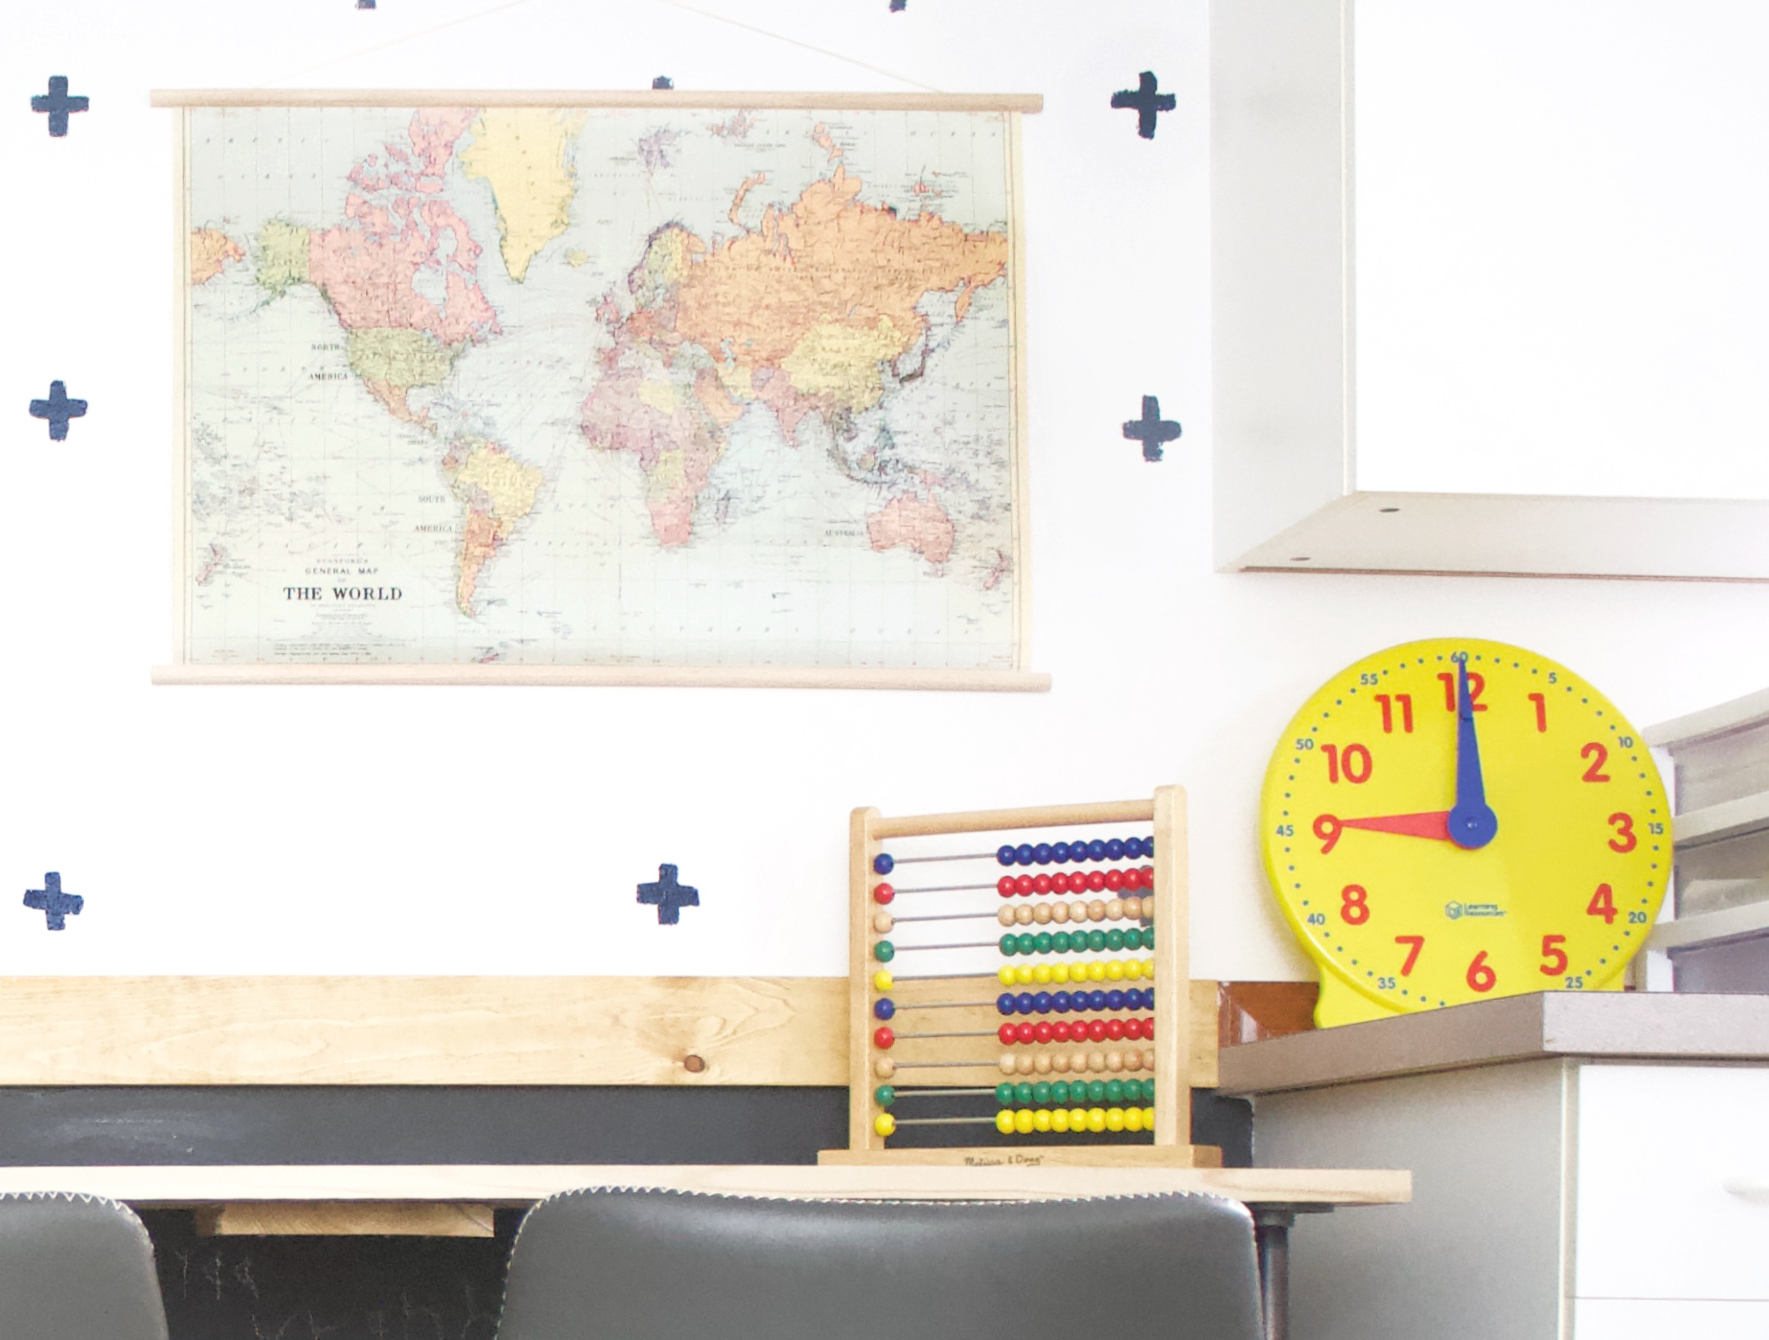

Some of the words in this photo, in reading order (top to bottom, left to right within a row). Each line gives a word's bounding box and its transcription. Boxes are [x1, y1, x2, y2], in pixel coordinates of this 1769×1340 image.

[415, 525, 453, 533] AMERICA
[305, 567, 352, 576] GENERAL
[358, 566, 379, 575] MAP
[283, 587, 323, 601] THE
[332, 587, 403, 601] WORLD
[1360, 672, 1379, 686] 55
[1548, 672, 1558, 685] 5
[1437, 671, 1488, 712] 12
[1374, 694, 1414, 734] 11
[1528, 692, 1547, 733] 1
[1295, 738, 1314, 751] 50
[1617, 735, 1634, 749] 10
[1321, 743, 1373, 784] 10
[1581, 742, 1611, 783] 2
[1275, 823, 1295, 837] 45
[1312, 813, 1343, 854] 9
[1607, 811, 1638, 854] 3
[1648, 821, 1665, 835] 15
[1340, 884, 1371, 926] 8
[1586, 883, 1618, 924] 4
[1307, 912, 1326, 926] 40
[1628, 910, 1648, 925] 20
[1394, 935, 1425, 977] 7
[1539, 934, 1569, 976] 5
[1466, 950, 1497, 993] 6
[1377, 976, 1397, 990] 35
[1565, 975, 1584, 989] 25
